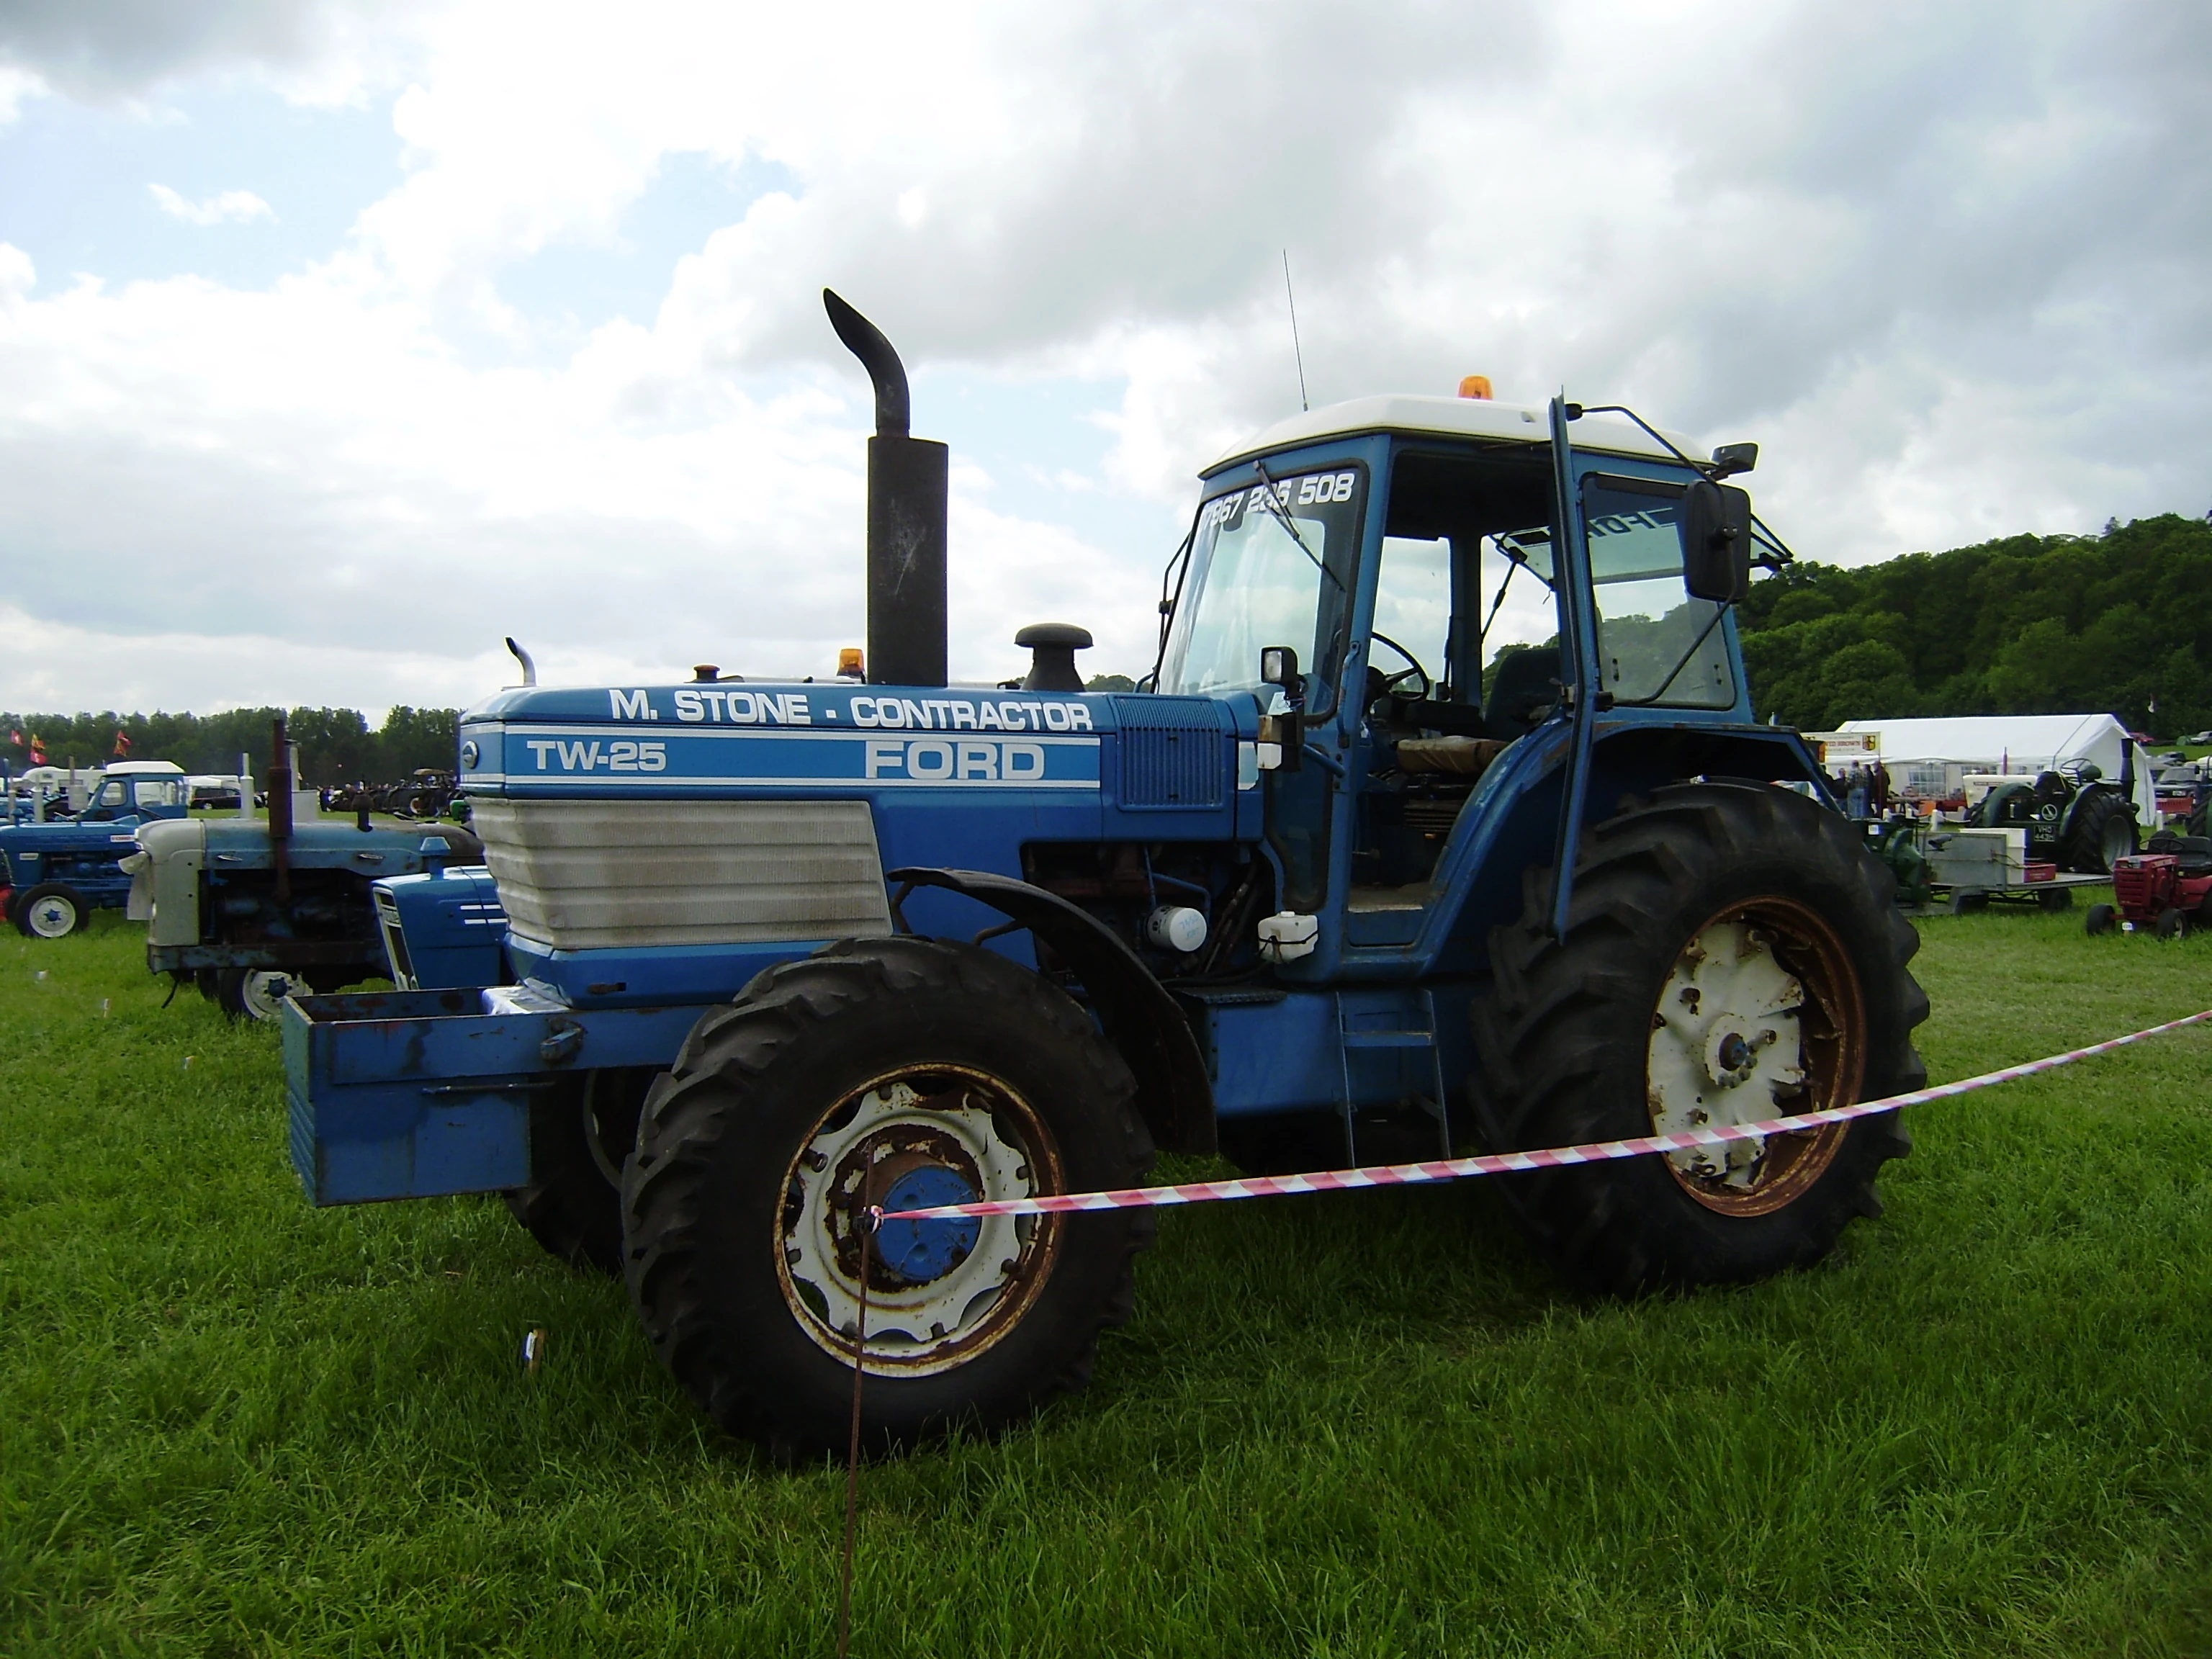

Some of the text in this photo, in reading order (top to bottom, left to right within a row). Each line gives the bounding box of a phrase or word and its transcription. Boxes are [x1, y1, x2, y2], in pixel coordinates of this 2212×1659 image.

[1298, 473, 1354, 505] 508
[609, 689, 658, 720] M.
[675, 690, 811, 724] STONE
[850, 696, 1093, 731] CONTRACTOR
[526, 740, 667, 772] TW-25
[866, 741, 1045, 780] FORD
